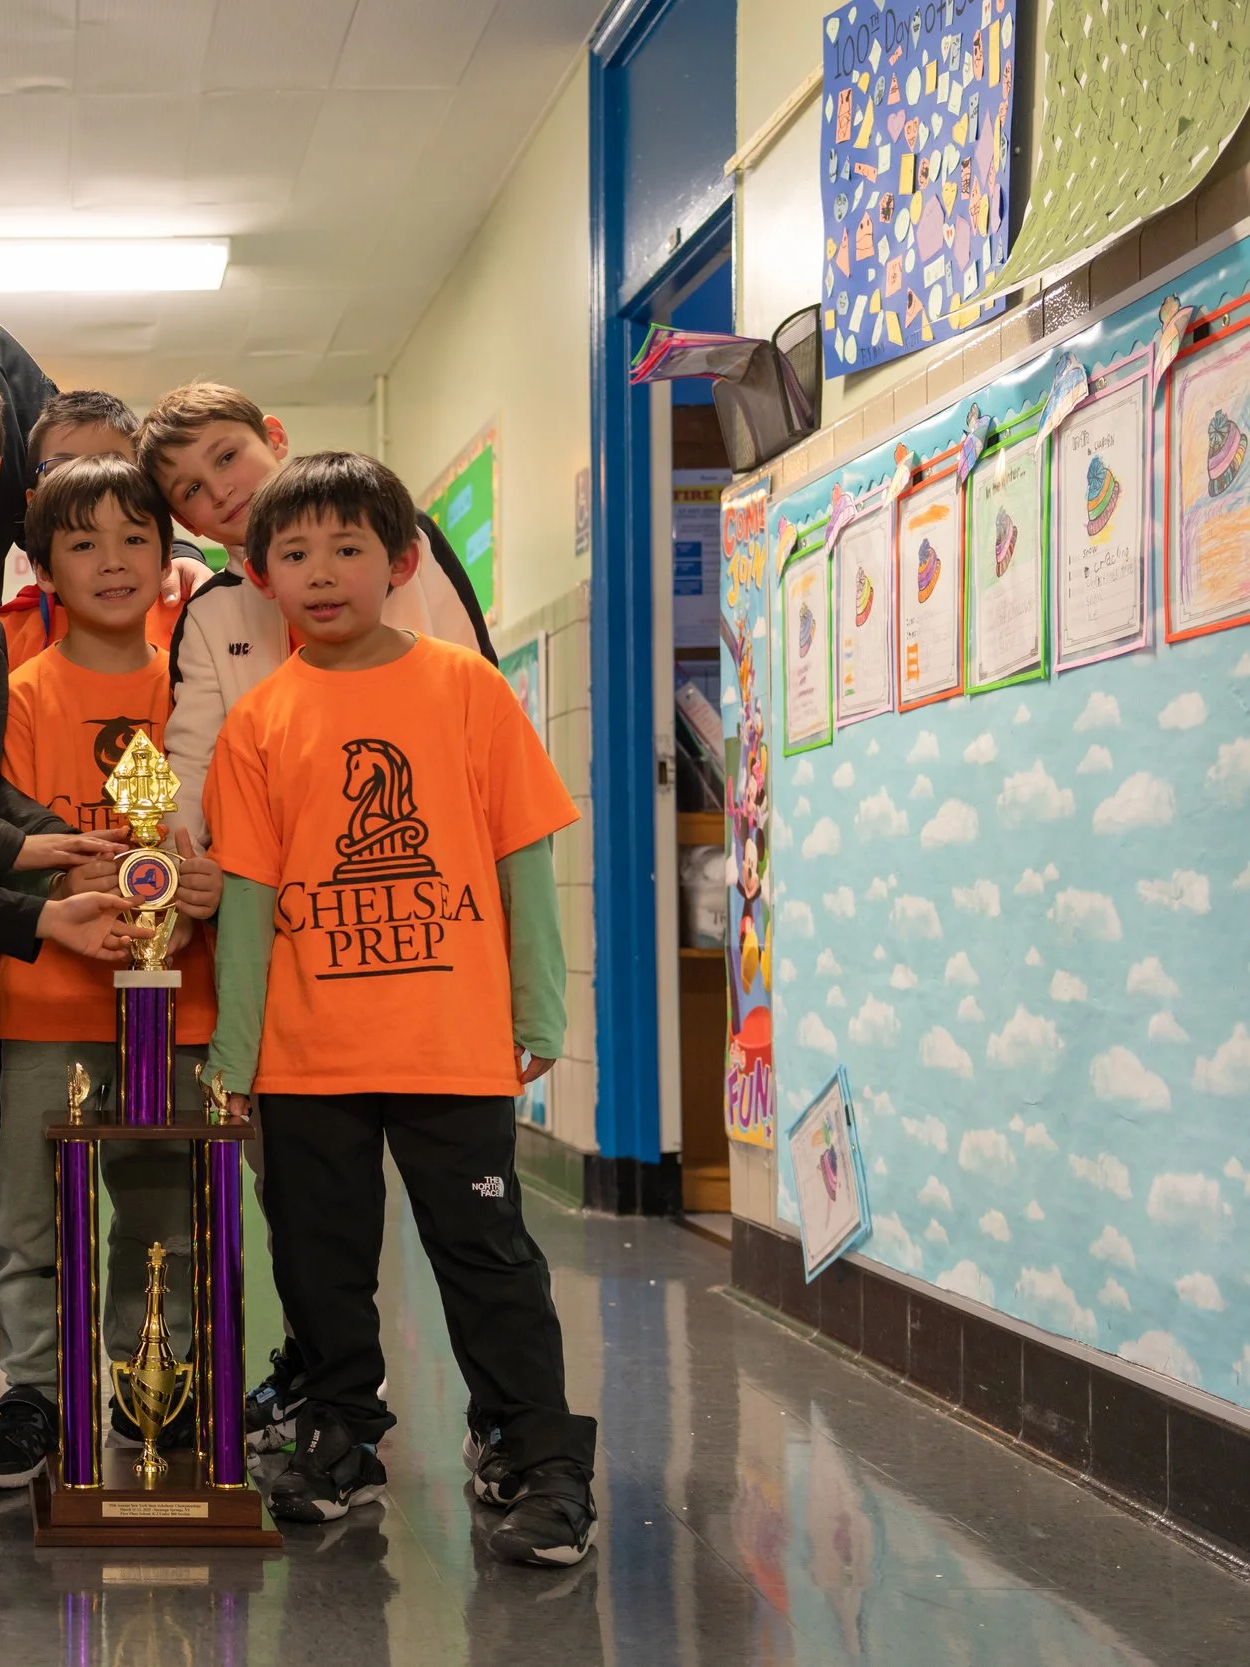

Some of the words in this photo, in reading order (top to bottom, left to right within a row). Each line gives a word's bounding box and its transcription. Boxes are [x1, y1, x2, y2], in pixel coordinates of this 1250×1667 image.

[277, 881, 485, 933] CHELSEA
[324, 921, 445, 968] PREP
[484, 1176, 501, 1184] THE
[471, 1182, 501, 1191] NORTH
[480, 1189, 501, 1197] FACE
